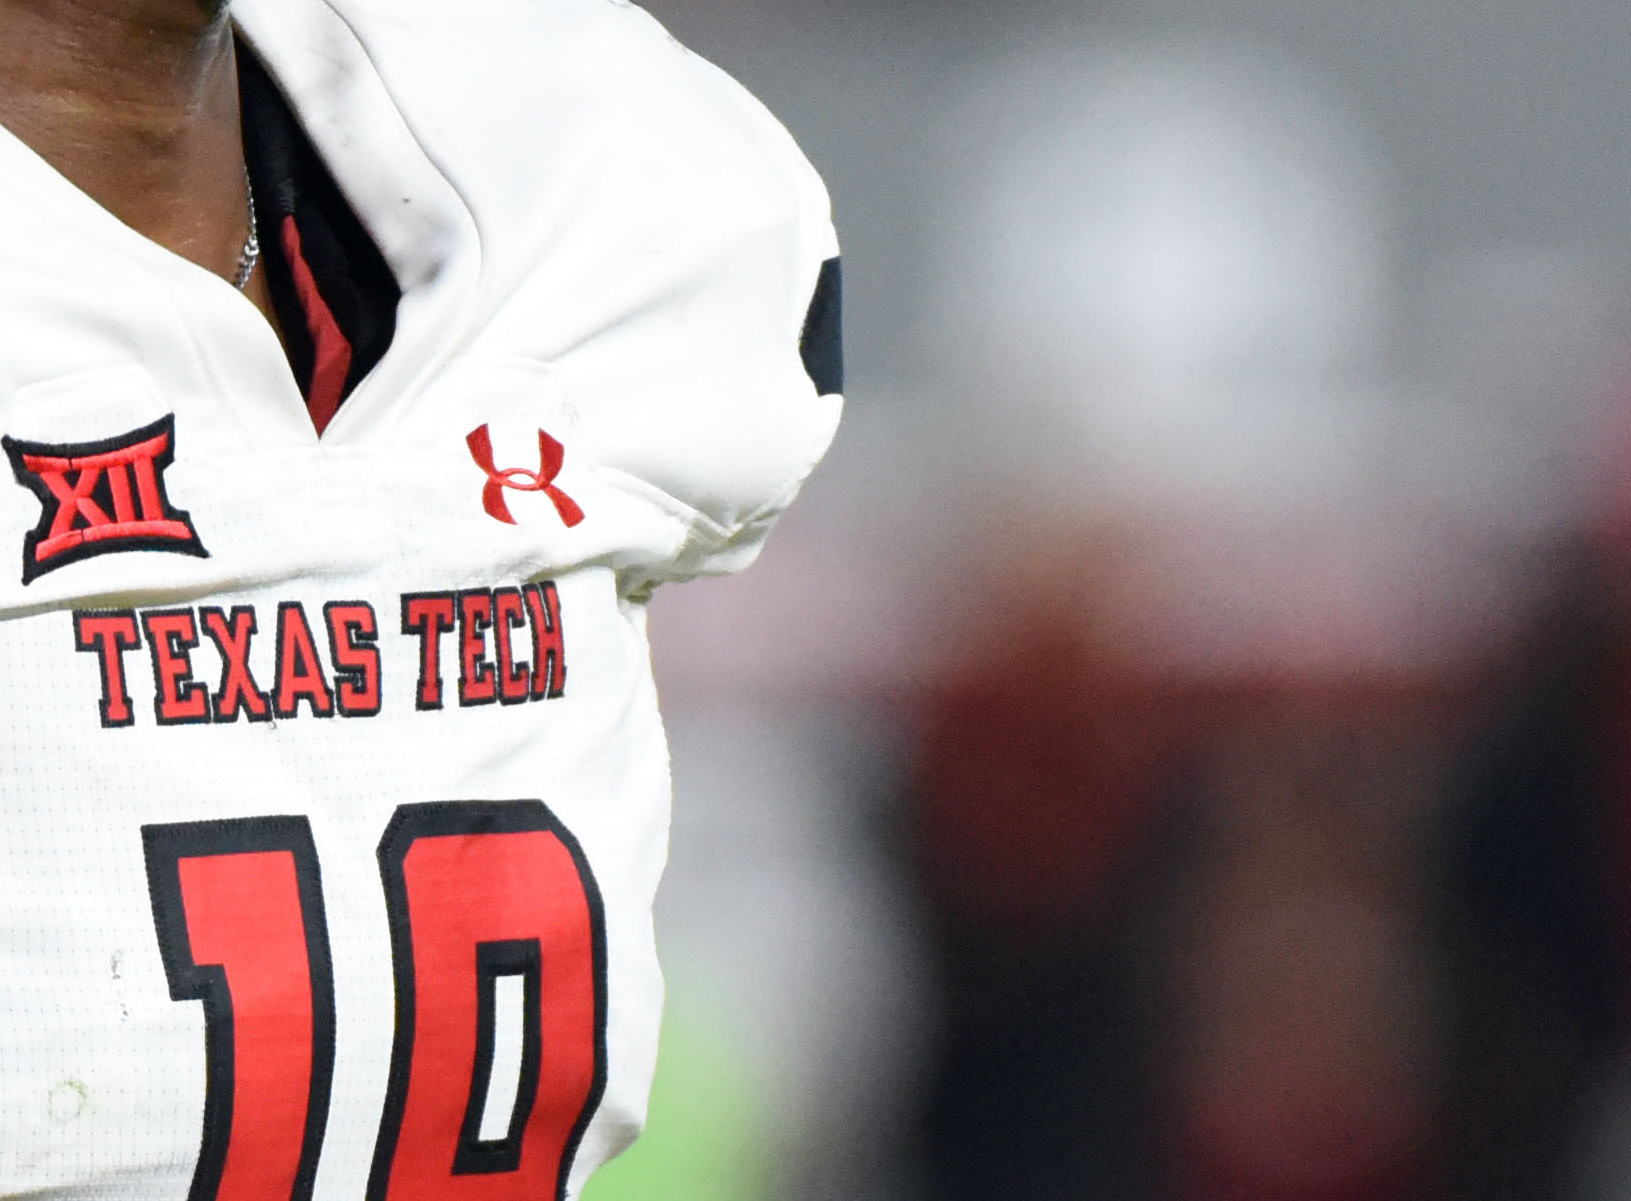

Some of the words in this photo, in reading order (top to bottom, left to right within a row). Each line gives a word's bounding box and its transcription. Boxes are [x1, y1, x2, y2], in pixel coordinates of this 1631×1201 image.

[11, 421, 202, 574] XII
[73, 600, 383, 729] TEXAS
[400, 580, 567, 711] TECH
